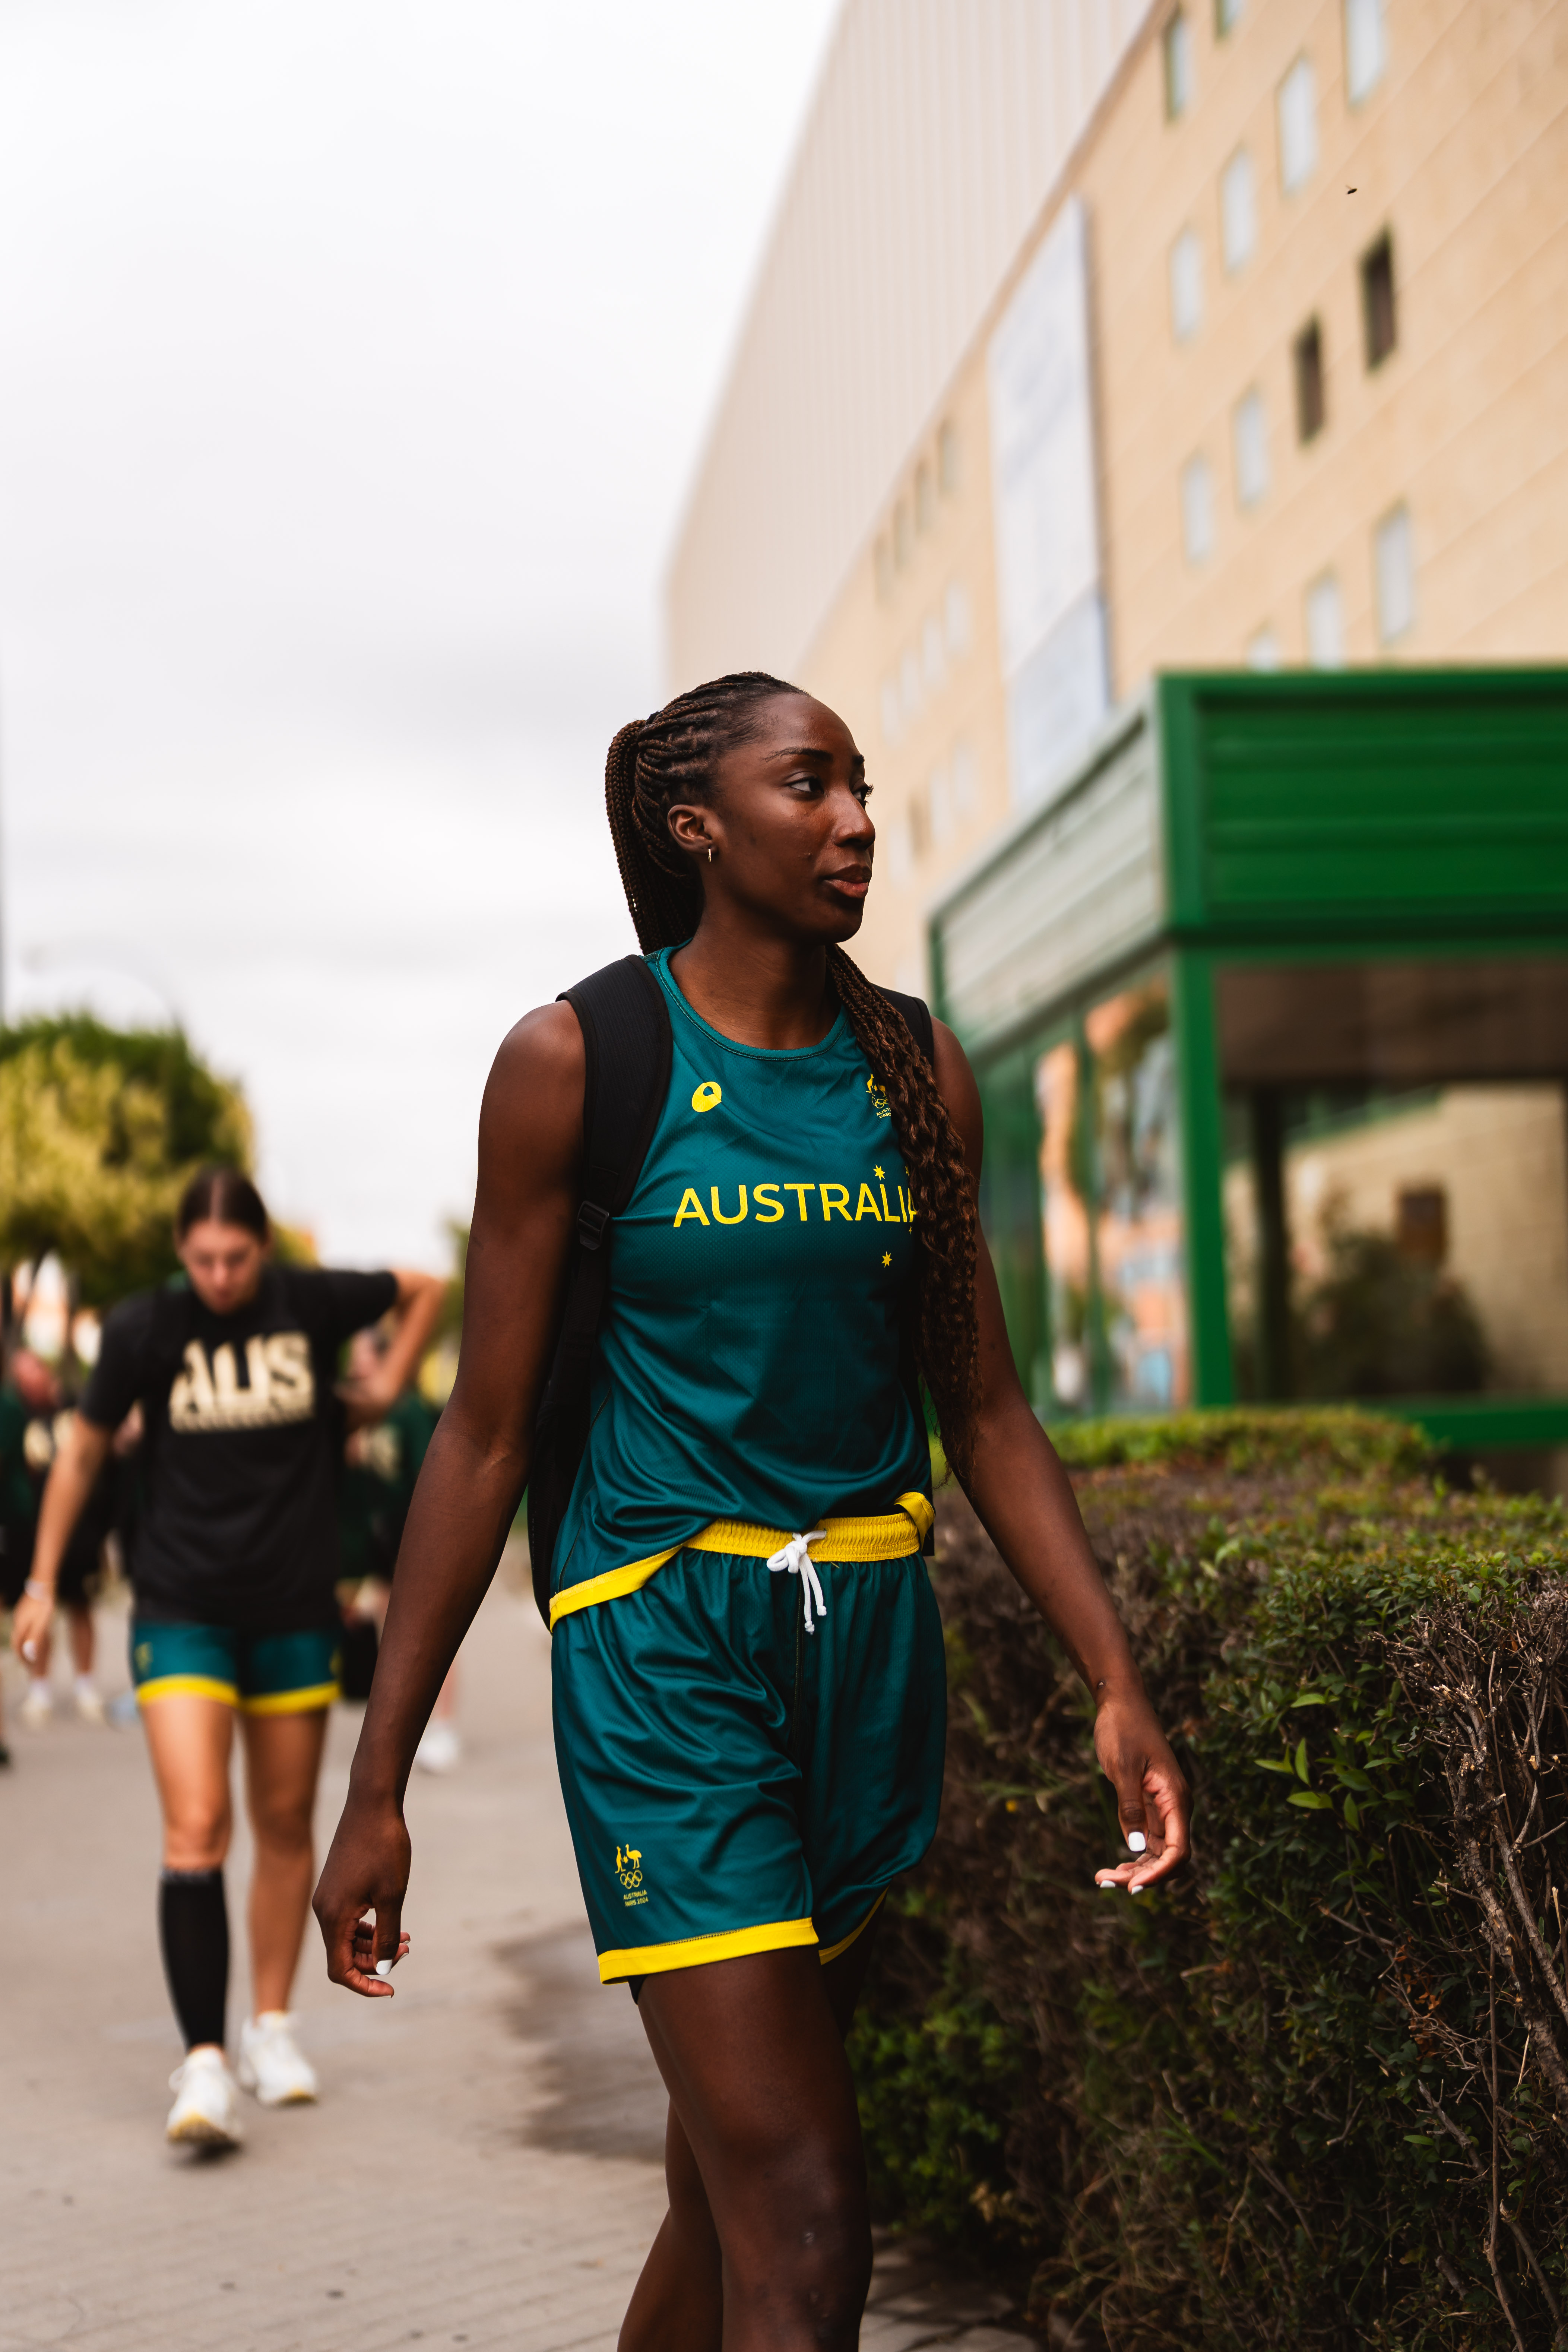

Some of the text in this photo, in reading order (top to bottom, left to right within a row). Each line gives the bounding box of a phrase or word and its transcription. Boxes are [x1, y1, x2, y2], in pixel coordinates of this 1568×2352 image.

[170, 1331, 316, 1416] AUS
[623, 1889, 647, 1900] AUSTRALIA
[637, 1896, 649, 1905] 2024
